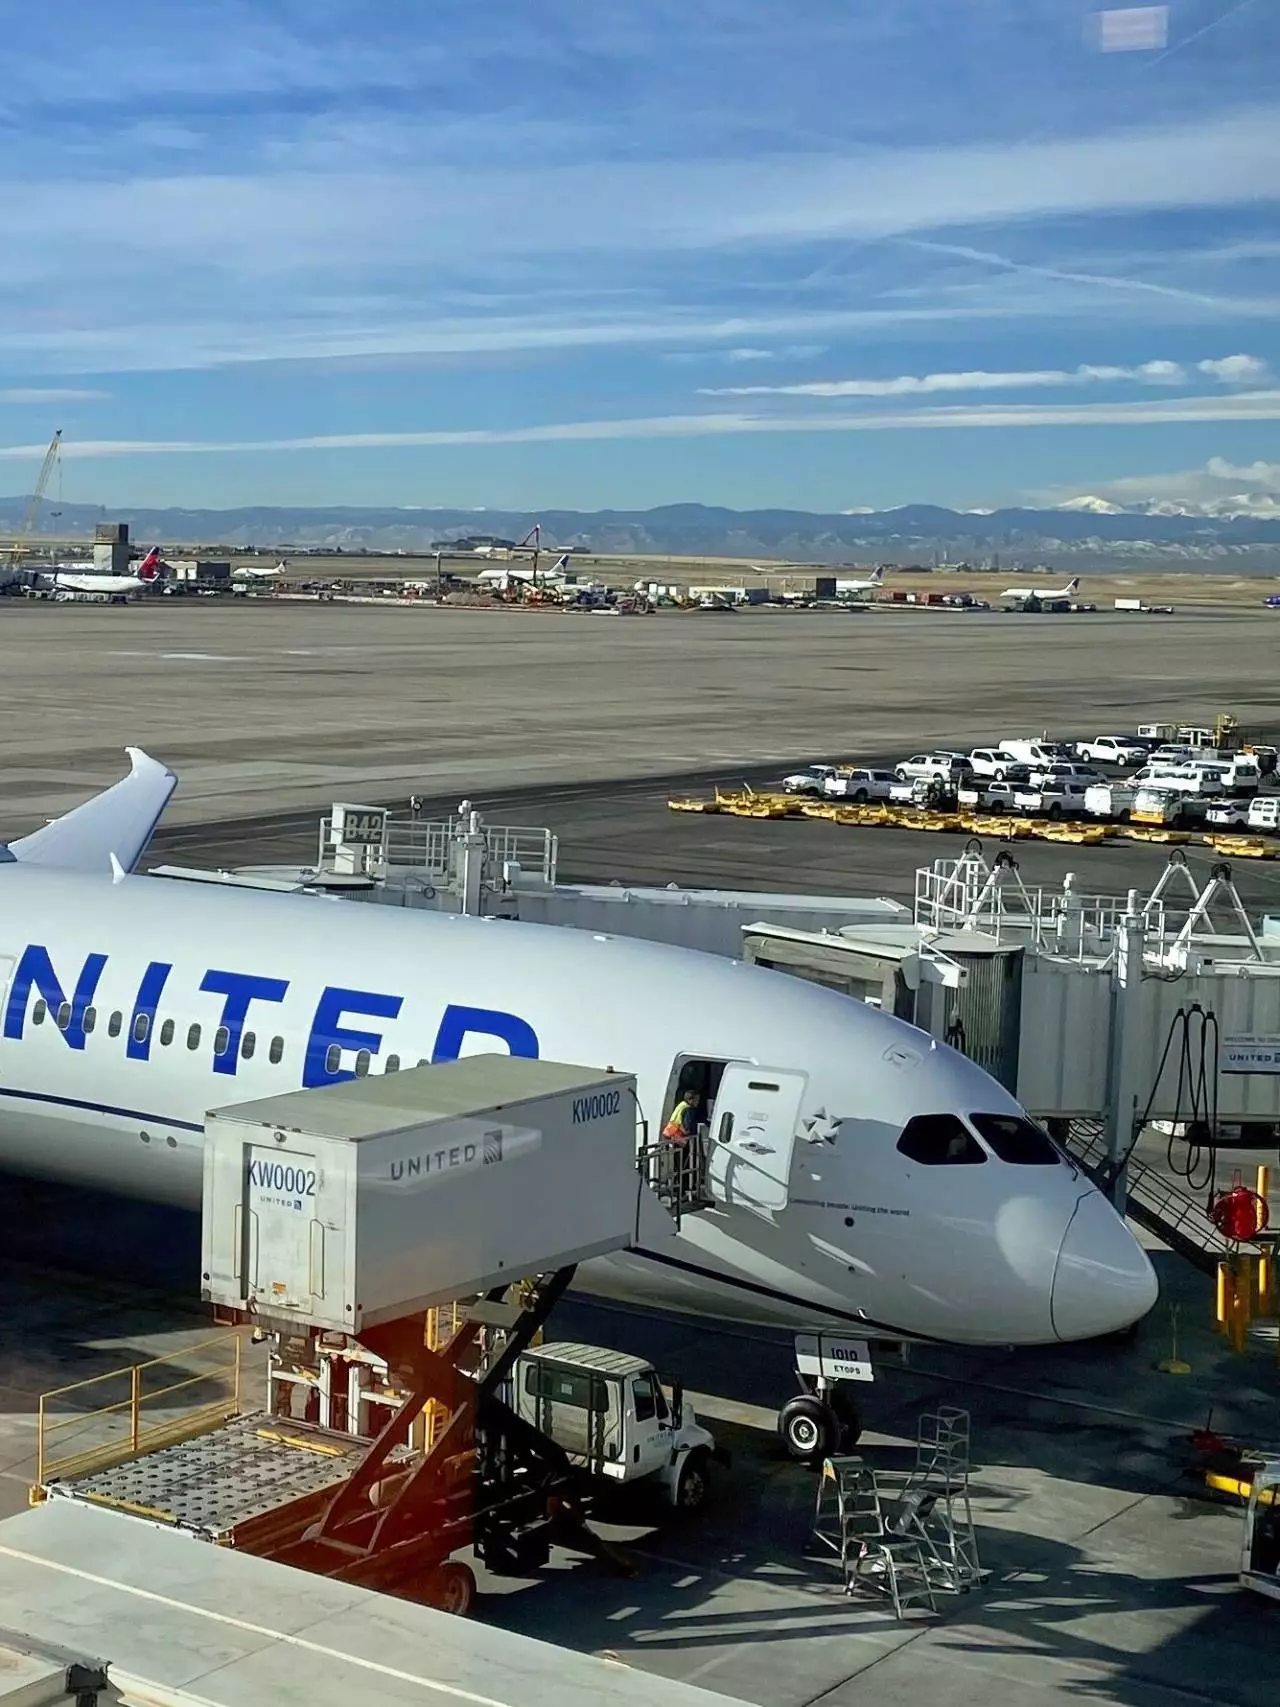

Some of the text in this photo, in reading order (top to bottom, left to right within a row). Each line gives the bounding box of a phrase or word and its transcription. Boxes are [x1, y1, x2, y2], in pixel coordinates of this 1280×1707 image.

[345, 814, 382, 840] B42
[1228, 1053, 1272, 1062] UNITED
[573, 1090, 620, 1124] KW0002
[391, 1144, 476, 1181] UNITED
[247, 1160, 316, 1197] KW0002
[260, 1195, 292, 1207] UNITED
[831, 1347, 858, 1361] 1010
[833, 1364, 861, 1375] ETOPS
